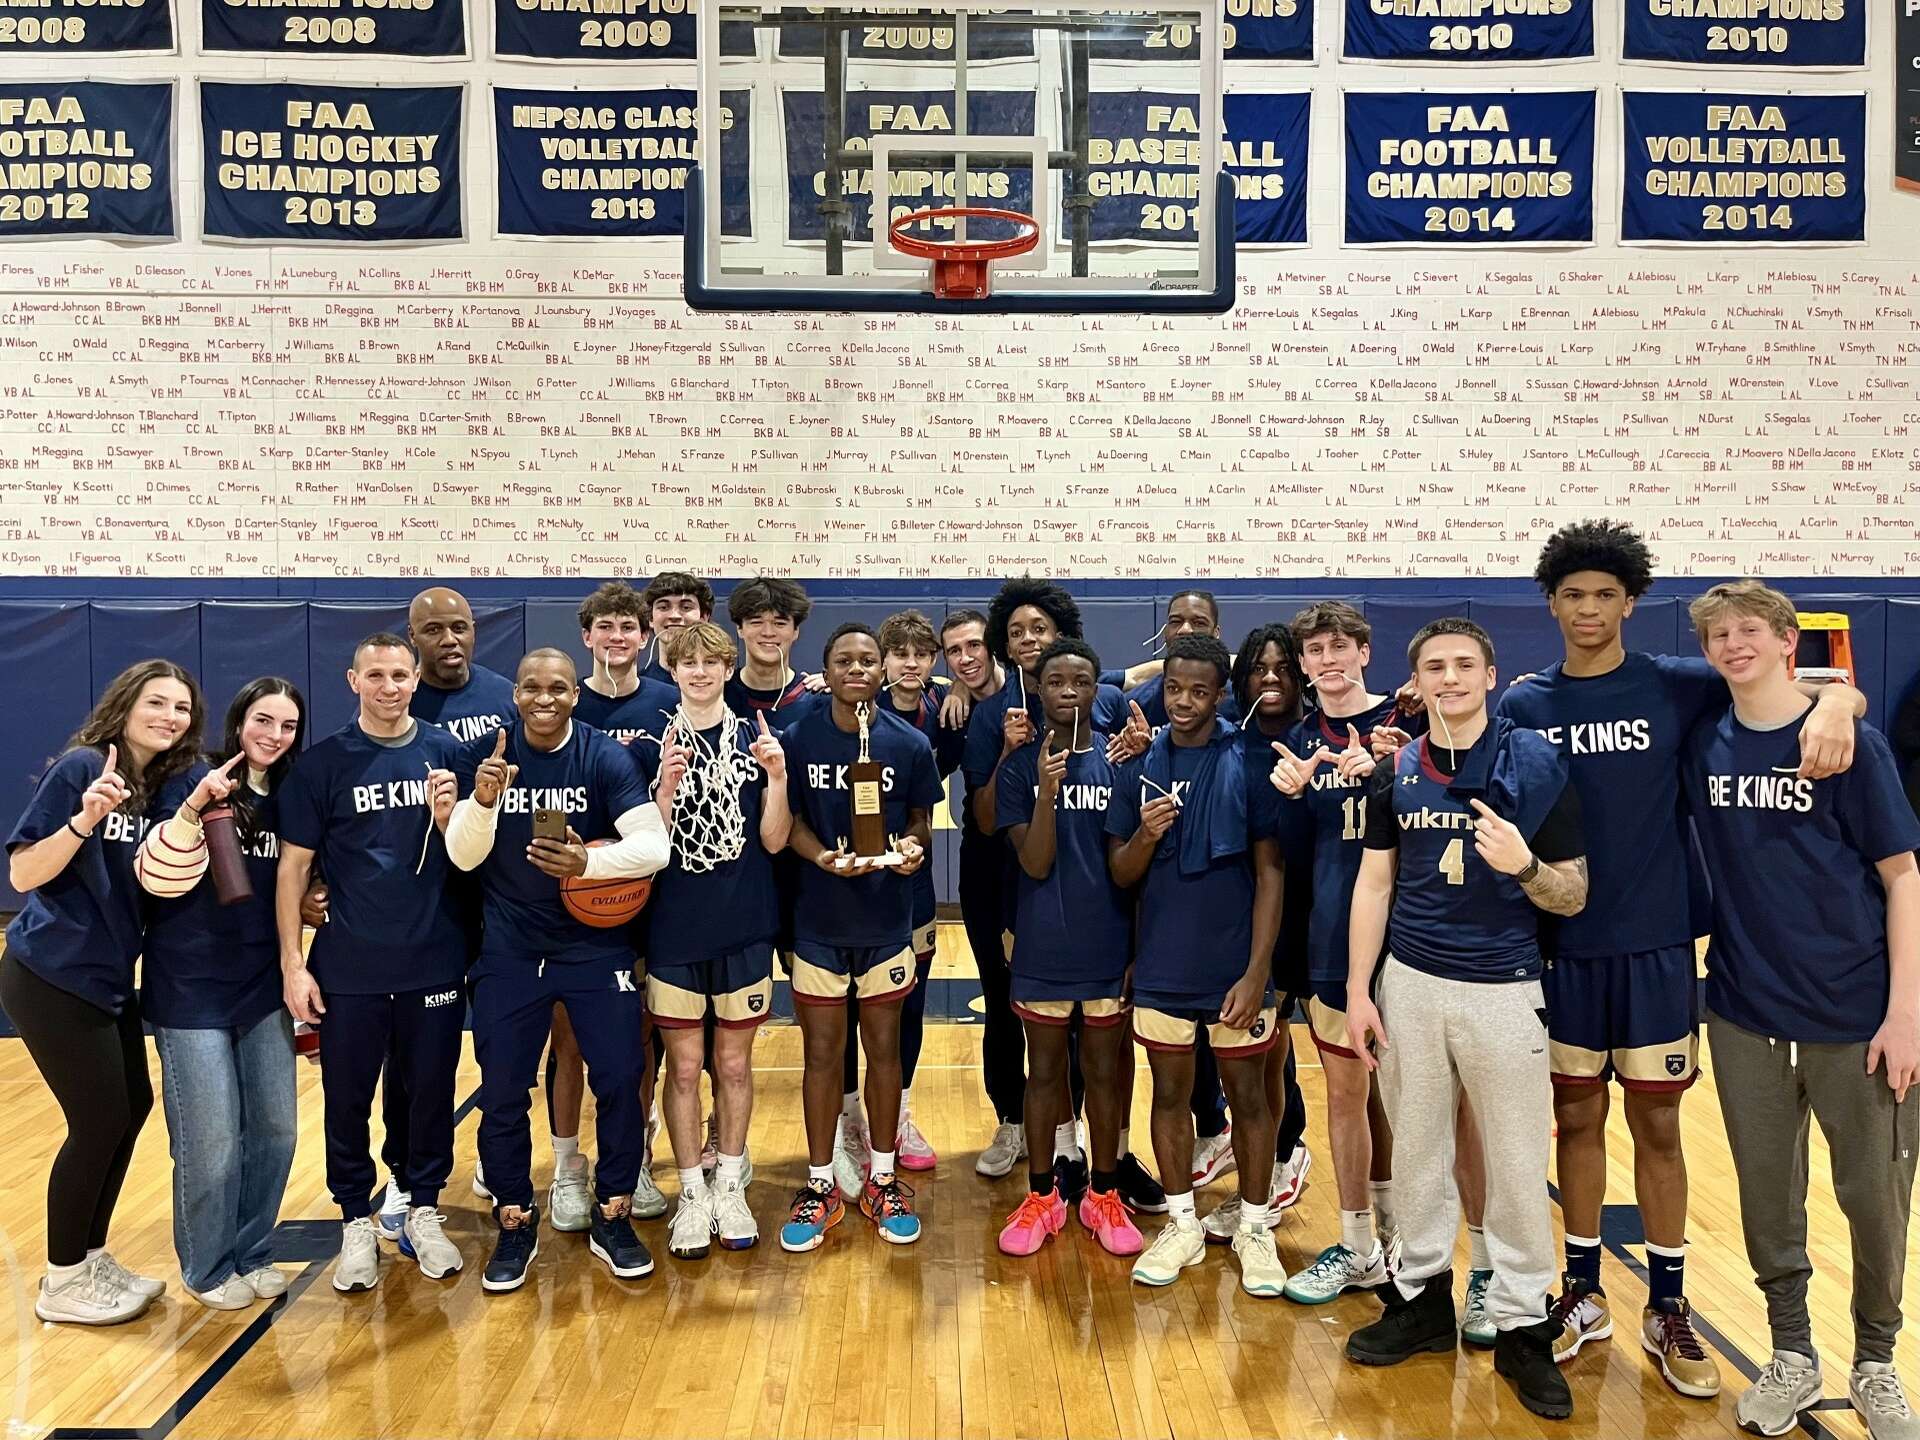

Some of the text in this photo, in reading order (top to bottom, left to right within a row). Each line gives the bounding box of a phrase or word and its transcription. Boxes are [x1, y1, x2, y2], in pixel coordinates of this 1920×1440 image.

[1650, 0, 1845, 20] CHAMPIONS
[0, 17, 86, 43] 2008
[285, 17, 376, 44] 2008
[580, 20, 672, 48] 2009
[863, 27, 954, 49] 2009
[1429, 23, 1513, 50] 2010
[1706, 26, 1788, 53] 2010
[0, 97, 86, 126] FAA
[287, 101, 374, 130] FAA
[512, 106, 616, 130] NEPSAC
[869, 105, 952, 131] FAA
[1146, 105, 1228, 134] FA
[1427, 105, 1510, 133] FAA
[1706, 105, 1787, 131] FAA
[220, 130, 437, 164] ICE HOCKEY
[1379, 139, 1557, 167] FOOTBALL
[1646, 137, 1845, 164] VOLLEYBALL
[218, 163, 441, 194] CHAMPIONS
[541, 168, 688, 191] CHAMPION
[1645, 169, 1847, 198] CHAMPIONS
[1088, 170, 1284, 201] CHAMPNS
[1367, 172, 1573, 200] CHAMPIONS
[0, 192, 91, 222] 2012
[285, 198, 377, 226] 2013
[590, 197, 657, 221] 2013
[1140, 203, 1200, 232] 201
[1424, 207, 1515, 233] 2014
[1702, 204, 1793, 231] 2014
[64, 264, 104, 274] L.Fisher
[136, 265, 185, 275] D.Gleason
[215, 266, 252, 277] V.Jones
[359, 268, 400, 278] N.Collins
[574, 270, 615, 280] K.DeMar
[506, 269, 539, 282] O.Gray
[1348, 273, 1391, 282] C.Nourse
[1414, 272, 1458, 282] C.Sievert
[1486, 272, 1533, 284] K.Segalas
[1842, 272, 1879, 285] S.Carey
[182, 279, 214, 290] CC AL
[395, 280, 430, 290] BKB AL
[1811, 284, 1840, 294] TN HM
[178, 303, 221, 312] J.Bonnell
[251, 304, 291, 314] J.Herritt
[609, 306, 656, 319] J.Voyages
[1521, 307, 1570, 317] E.Brennan
[1664, 306, 1705, 316] M.Pakula
[1807, 307, 1842, 320] V.Smyth
[141, 314, 180, 326] BKB HM
[1390, 308, 1418, 320] J.King
[1461, 308, 1492, 320] L.Karp
[1503, 321, 1526, 331] L HM
[360, 340, 399, 350] B.Brown
[437, 341, 470, 351] A.Rand
[497, 341, 549, 351] C.McQuilkin
[720, 342, 765, 352] S.Sullivan
[929, 344, 964, 353] H.Smith
[997, 344, 1027, 354] A.Leist
[1696, 342, 1746, 355] W.Tryhane
[1746, 355, 1770, 365] G HM
[110, 375, 148, 388] A.Smyth
[473, 377, 511, 387] J.Wilson
[537, 377, 577, 387] G.Potter
[608, 377, 655, 388] J.Williams
[1248, 378, 1281, 391] S.Huley
[1667, 377, 1707, 387] A.Arnold
[1729, 377, 1784, 387] W.Orenstein
[858, 392, 895, 402] BKB HM
[218, 411, 256, 423] T.Tipton
[579, 413, 620, 423] J.Bonnell
[1413, 414, 1458, 424] C.Sullivan
[1553, 414, 1598, 427] M.Staples
[1699, 413, 1733, 423] N.Durst
[1765, 413, 1811, 426] S.Segalas
[406, 447, 436, 457] H.Cole
[752, 449, 798, 459] P.Sullivan
[826, 450, 868, 462] J.Murray
[1180, 450, 1211, 459] C.Main
[1383, 449, 1421, 460] C.Potter
[1872, 448, 1904, 459] E.Klotz
[447, 461, 474, 471] S HM
[74, 481, 113, 491] K.Scotti
[218, 482, 259, 492] C.Morris
[712, 484, 765, 494] M.Goldstein
[1066, 485, 1109, 495] S.Franze
[1487, 483, 1526, 493] M.Keane
[1629, 483, 1670, 493] R.Rather
[1772, 482, 1806, 492] S.Shaw
[41, 516, 81, 527] T.Brown
[473, 518, 516, 528] D.Chimes
[538, 518, 583, 532] R.McNulty
[824, 520, 865, 530] V.Weiner
[1177, 520, 1215, 529] C.Harris
[1660, 517, 1703, 528] A.DeLuca
[1800, 517, 1837, 527] A.Carlin
[367, 553, 400, 567] C.Byrd
[437, 554, 470, 563] N.Wind
[792, 554, 821, 567] A.Tully
[931, 554, 967, 564] K.Keller
[1070, 554, 1107, 564] N.Couch
[1347, 554, 1390, 563] M.Perkins
[1570, 718, 1650, 755] KINGS
[807, 763, 830, 790] BE
[353, 783, 386, 814] BE
[504, 786, 588, 814] BE KINGS
[1708, 775, 1813, 813] BE KINGS
[1342, 796, 1367, 841] 11
[103, 811, 136, 844] BE
[1438, 838, 1465, 885] 4
[613, 970, 637, 992] K
[424, 990, 458, 1005] KING
